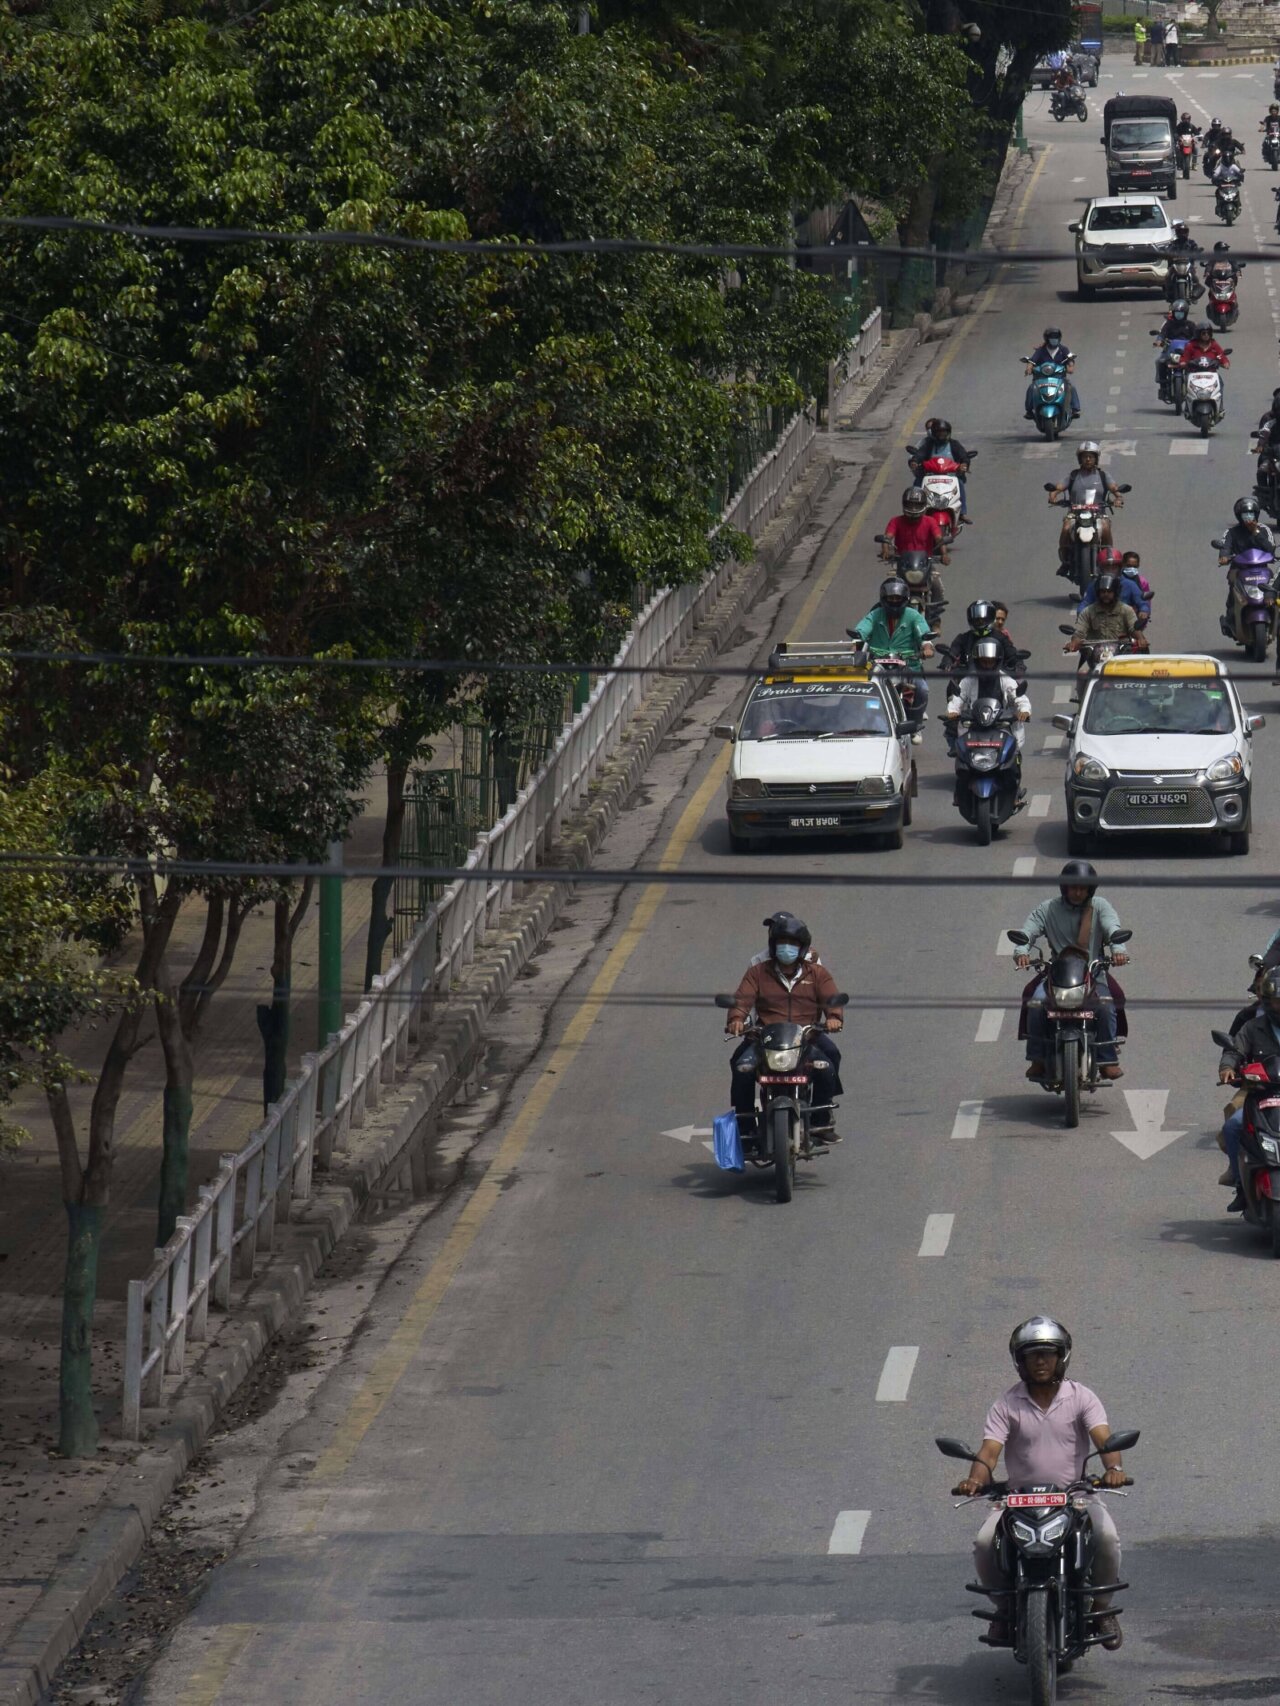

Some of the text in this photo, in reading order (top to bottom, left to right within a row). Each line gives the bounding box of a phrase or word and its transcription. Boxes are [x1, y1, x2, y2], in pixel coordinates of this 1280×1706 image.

[758, 684, 873, 697] Praise The Lord
